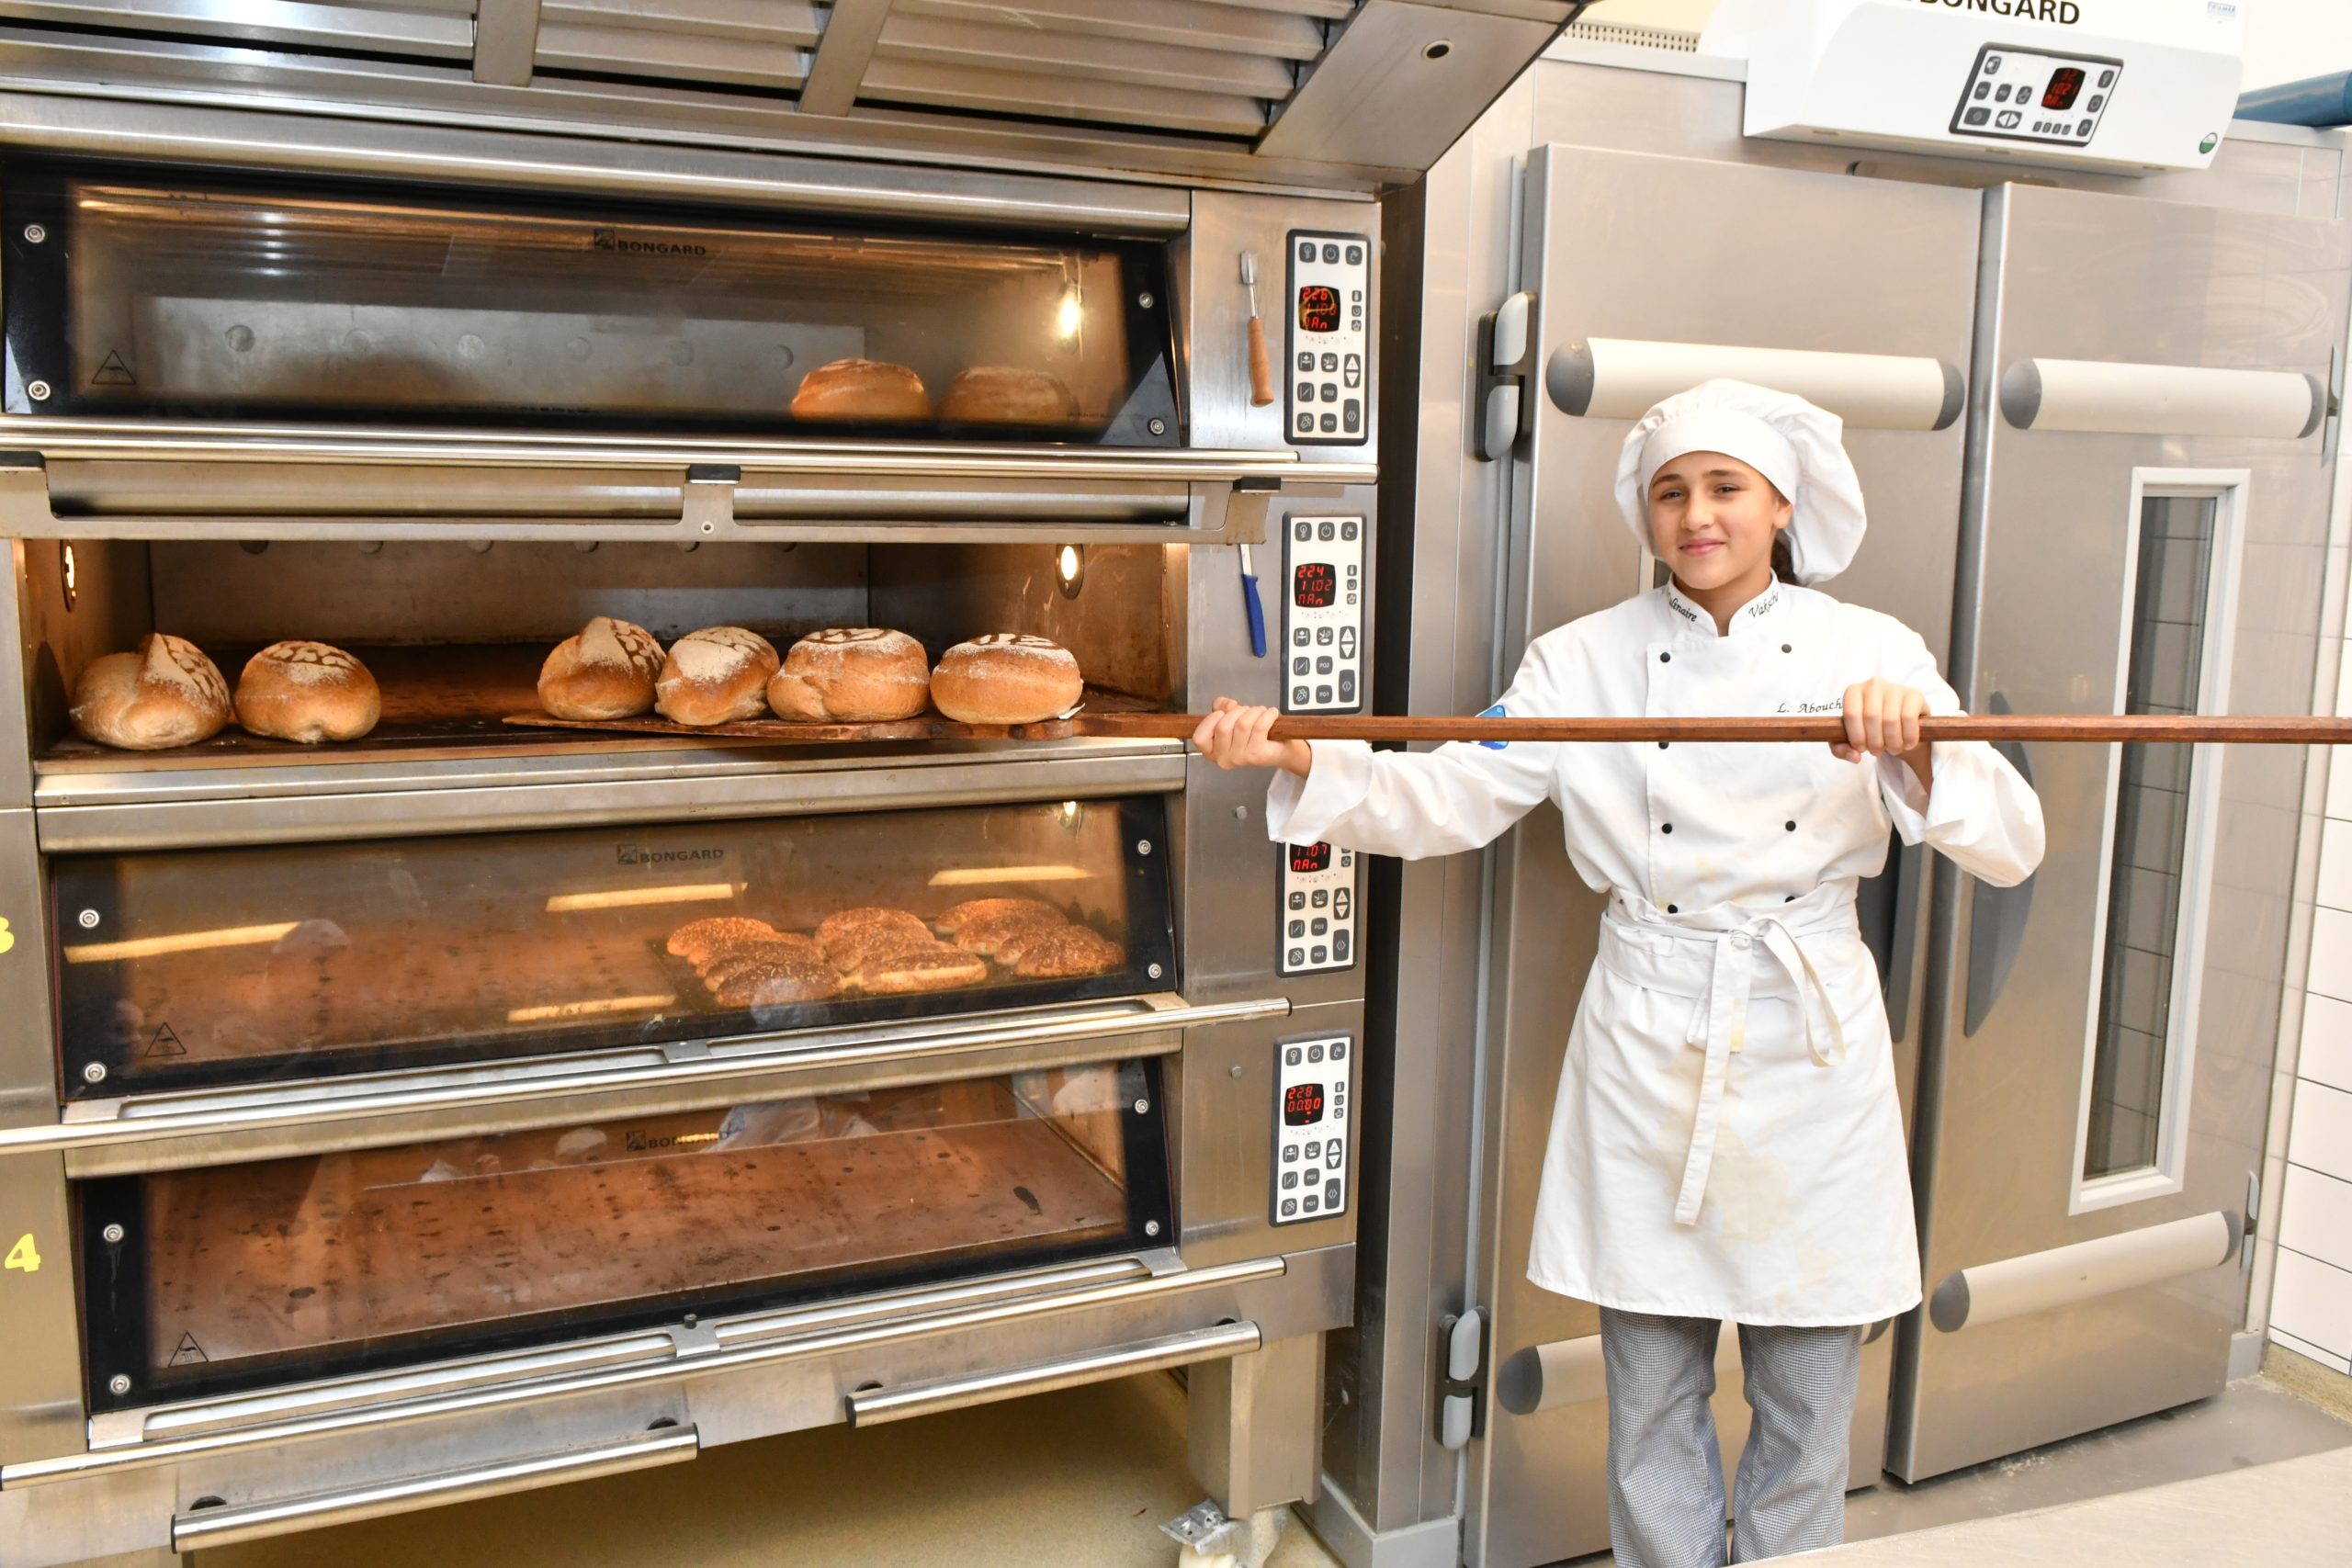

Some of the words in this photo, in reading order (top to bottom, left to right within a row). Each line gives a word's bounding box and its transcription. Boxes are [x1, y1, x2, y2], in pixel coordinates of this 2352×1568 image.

[1920, 0, 2081, 25] GARD
[617, 240, 706, 255] BONGARD
[1298, 565, 1324, 579] 224
[639, 849, 724, 863] BONGARD
[1288, 1086, 1313, 1100] 228
[5, 1234, 41, 1272] 4
